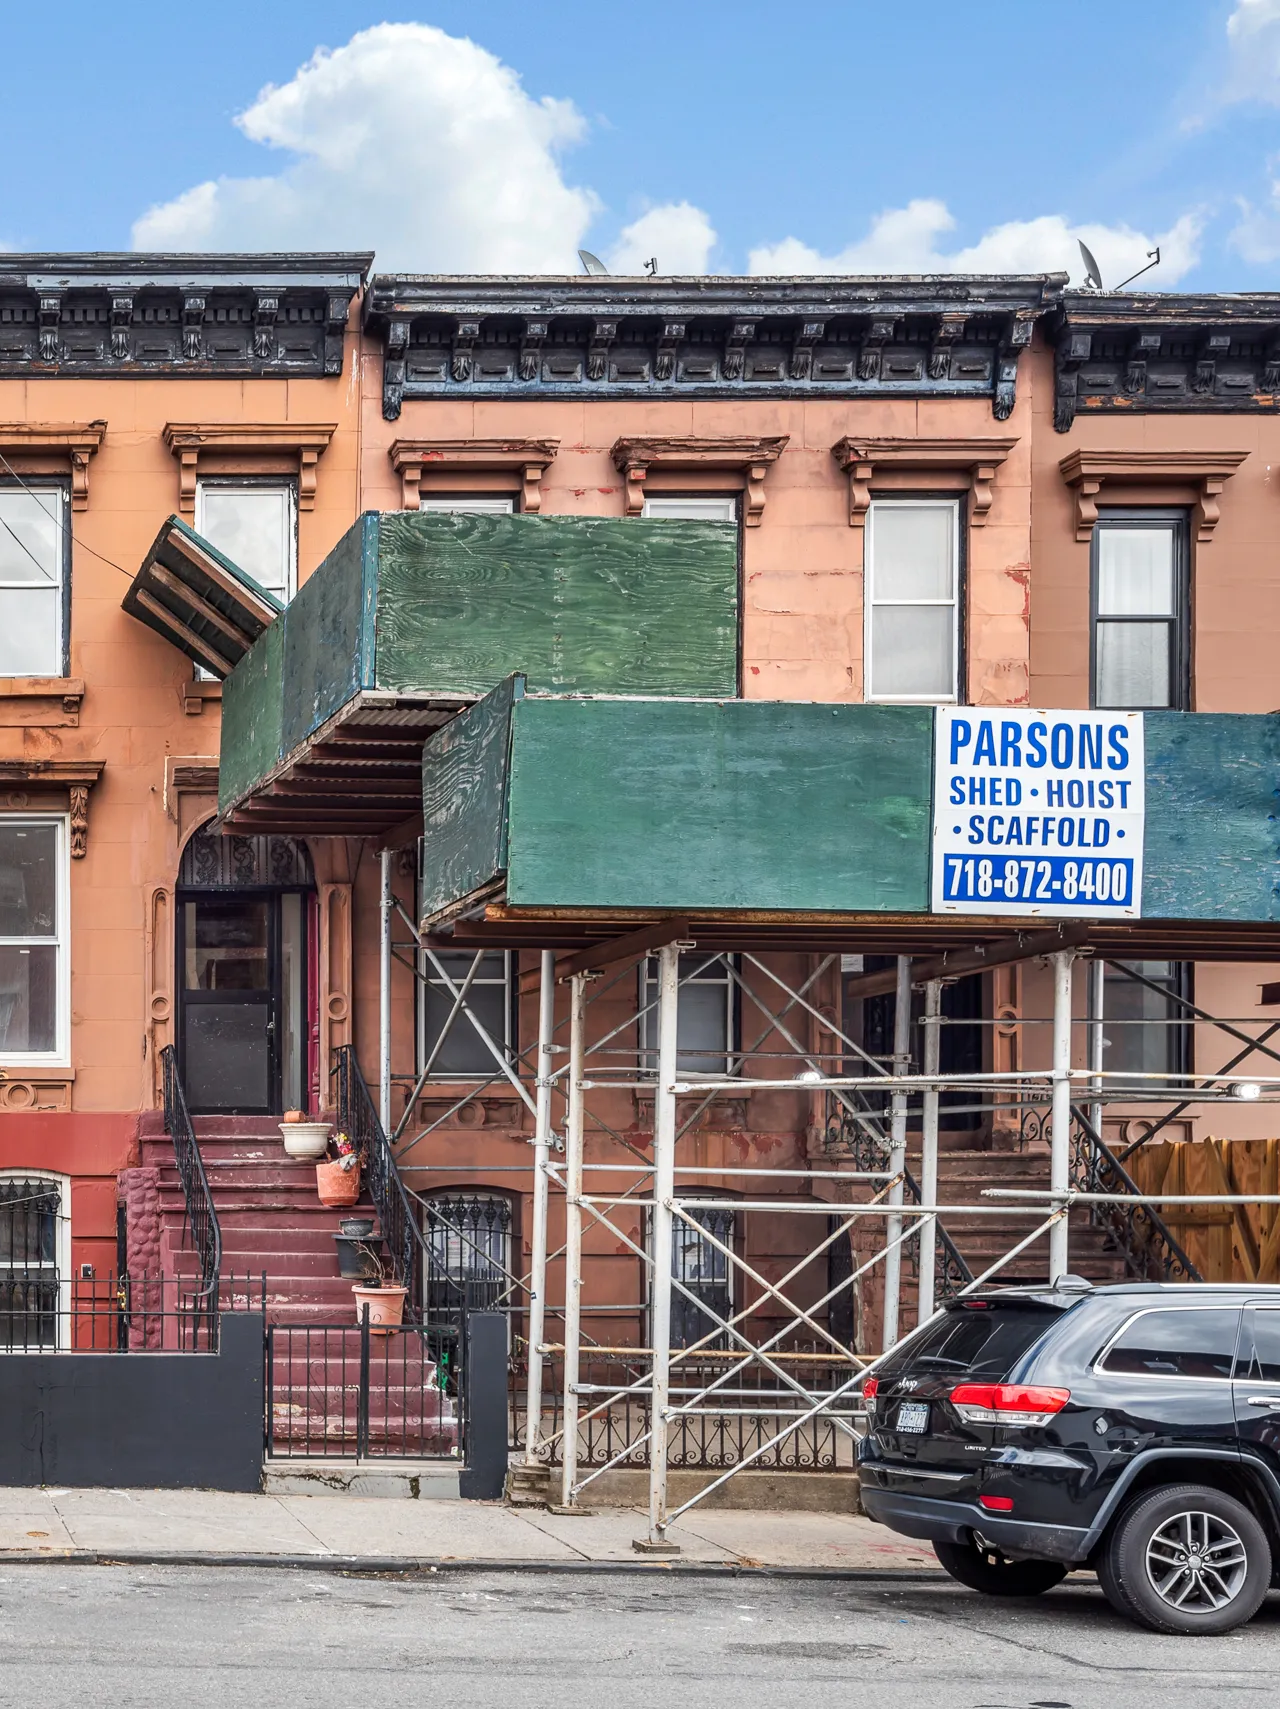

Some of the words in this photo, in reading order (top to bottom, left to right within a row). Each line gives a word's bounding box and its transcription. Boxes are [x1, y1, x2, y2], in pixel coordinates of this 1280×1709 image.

[949, 719, 1129, 771] PARSONS
[949, 776, 1023, 806] SHED
[1046, 779, 1132, 809] HOIST
[967, 815, 1110, 848] SCAFFOLD
[948, 858, 1128, 902] 718-872-8400
